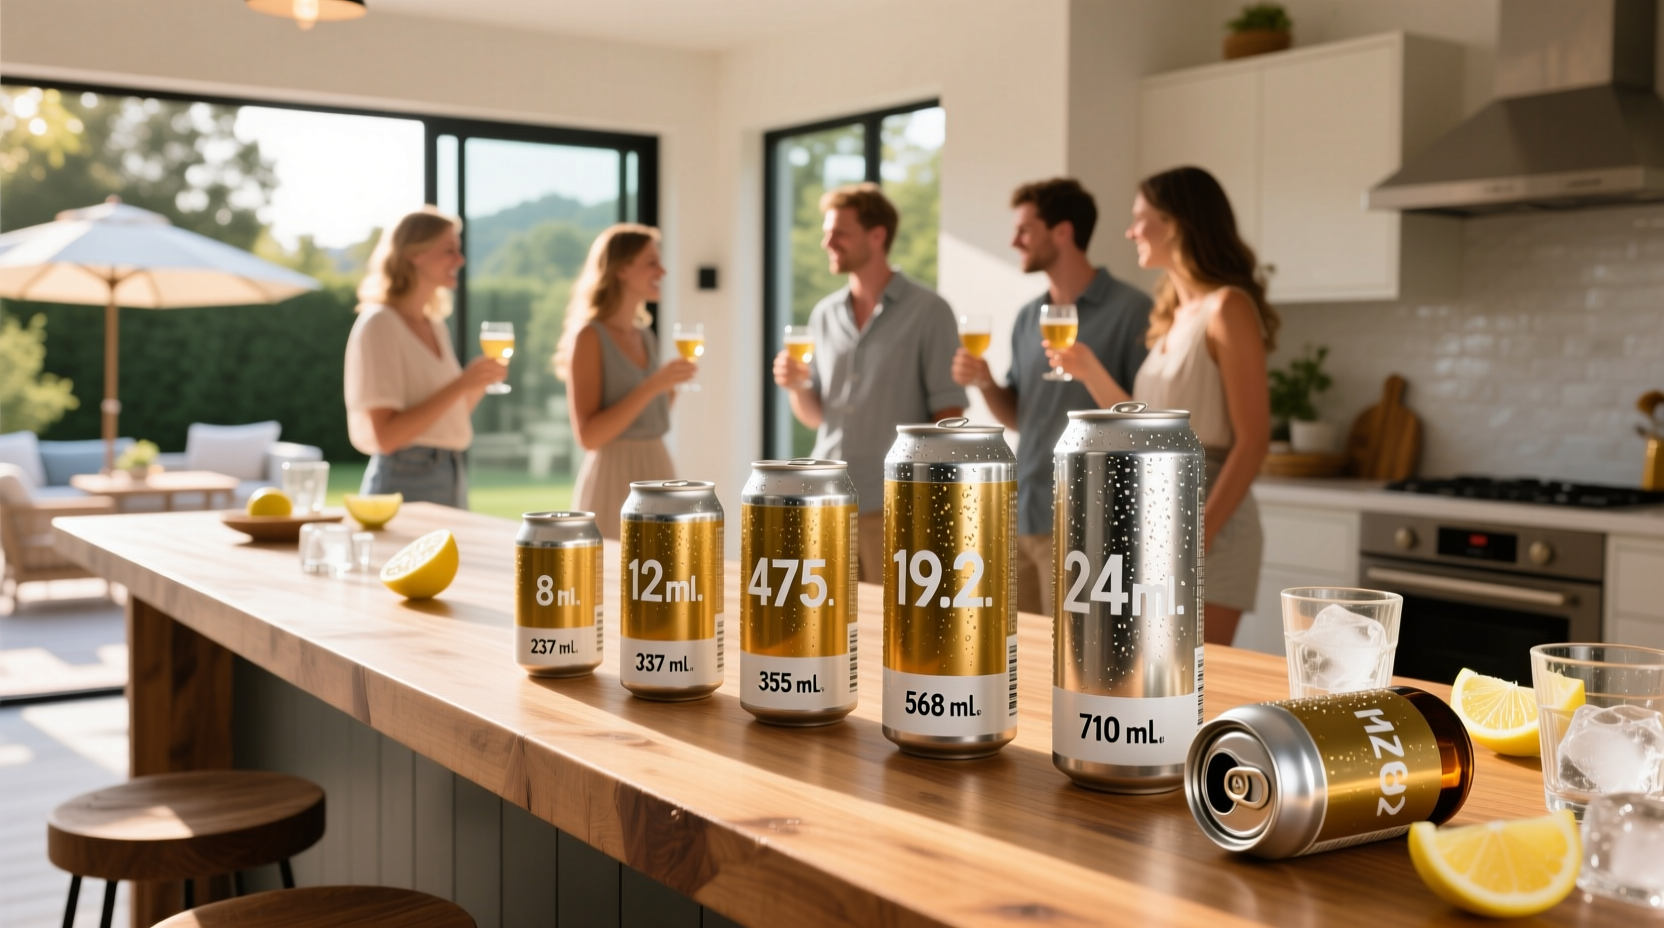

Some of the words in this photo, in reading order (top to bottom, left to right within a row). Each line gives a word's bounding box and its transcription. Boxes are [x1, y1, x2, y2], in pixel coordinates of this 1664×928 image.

[536, 575, 553, 606] 8
[748, 557, 834, 608] 475.
[530, 638, 556, 654] 237
[636, 653, 665, 672] 337
[758, 671, 792, 692] 355
[905, 691, 944, 716] 568
[1080, 713, 1120, 743] 710
